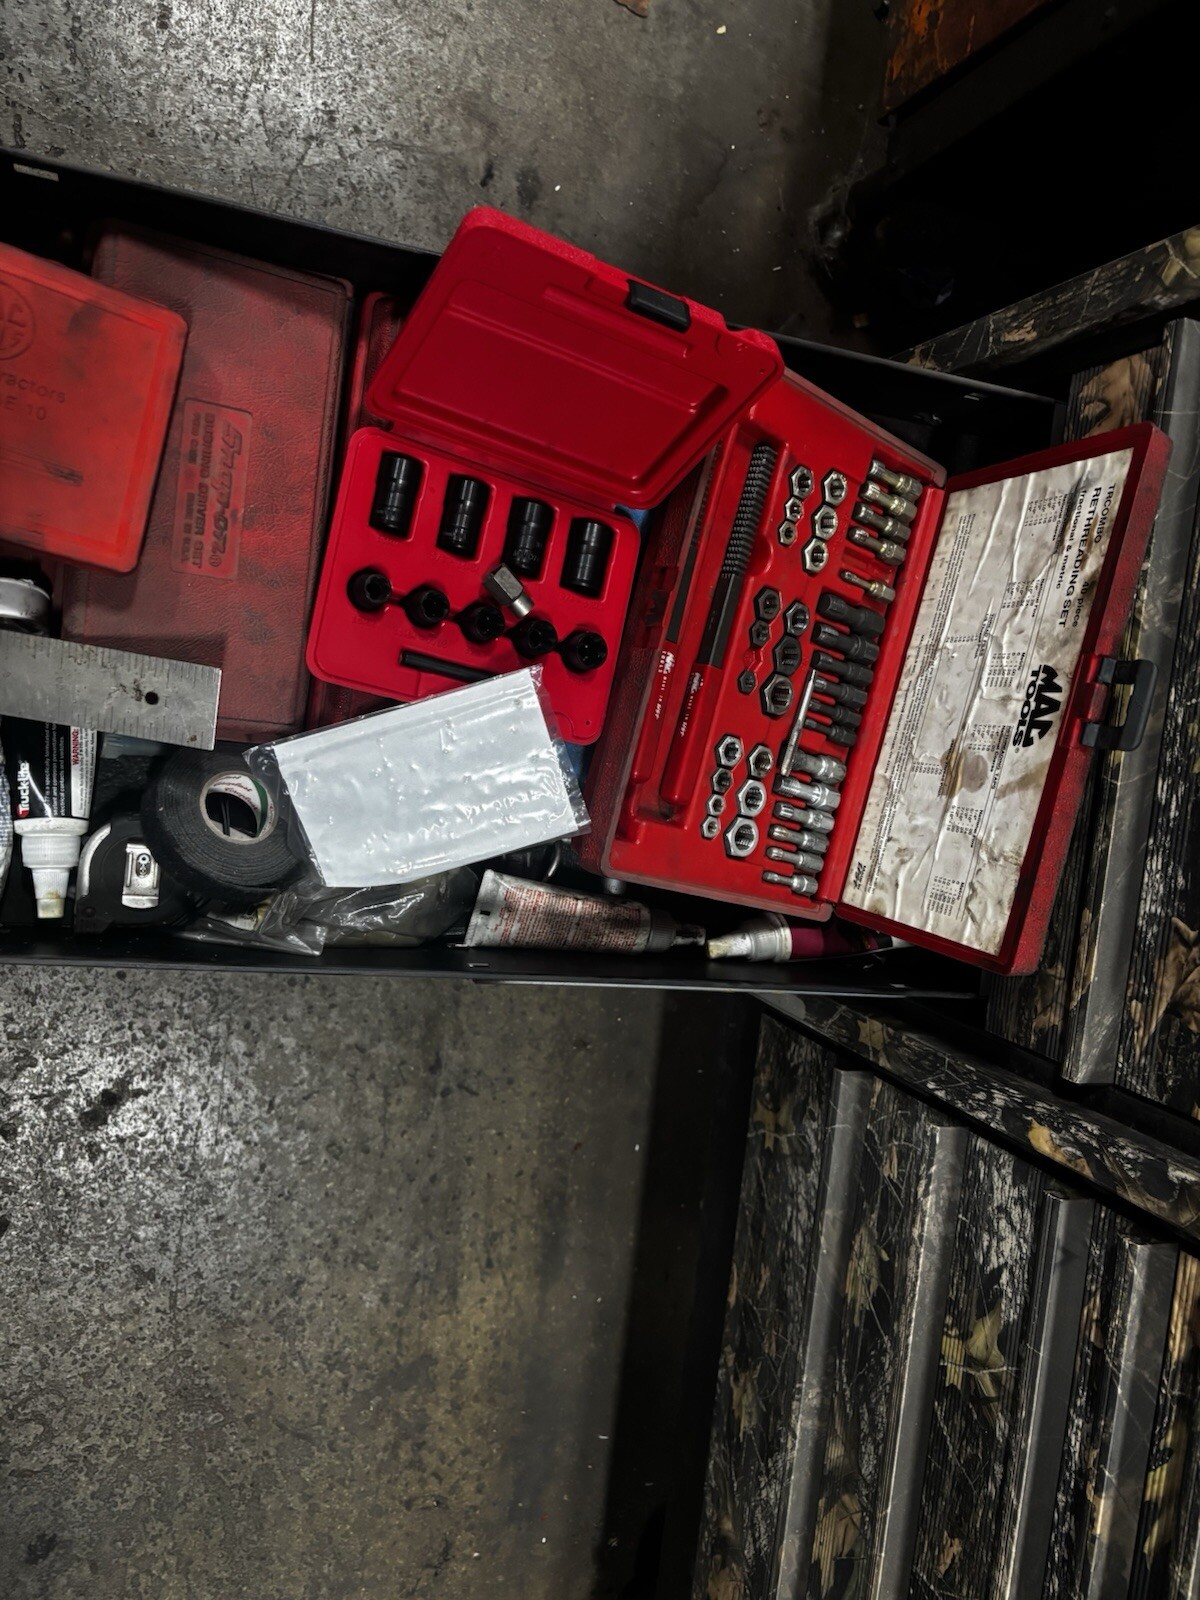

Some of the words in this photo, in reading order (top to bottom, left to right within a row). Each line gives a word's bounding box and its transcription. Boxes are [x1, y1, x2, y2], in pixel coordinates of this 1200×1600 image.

[0, 372, 66, 404] ractors
[211, 422, 243, 555] Snap-on
[1067, 489, 1087, 541] fractional
[1093, 483, 1115, 543] TRCOMBO
[1065, 486, 1102, 596] RETHREADING
[1065, 544, 1072, 552] &
[1054, 554, 1069, 589] metric
[1079, 580, 1089, 594] 40
[1057, 599, 1072, 628] SET
[1070, 597, 1085, 627] piece
[1011, 664, 1042, 747] TOOLS
[1022, 664, 1063, 748] MAC
